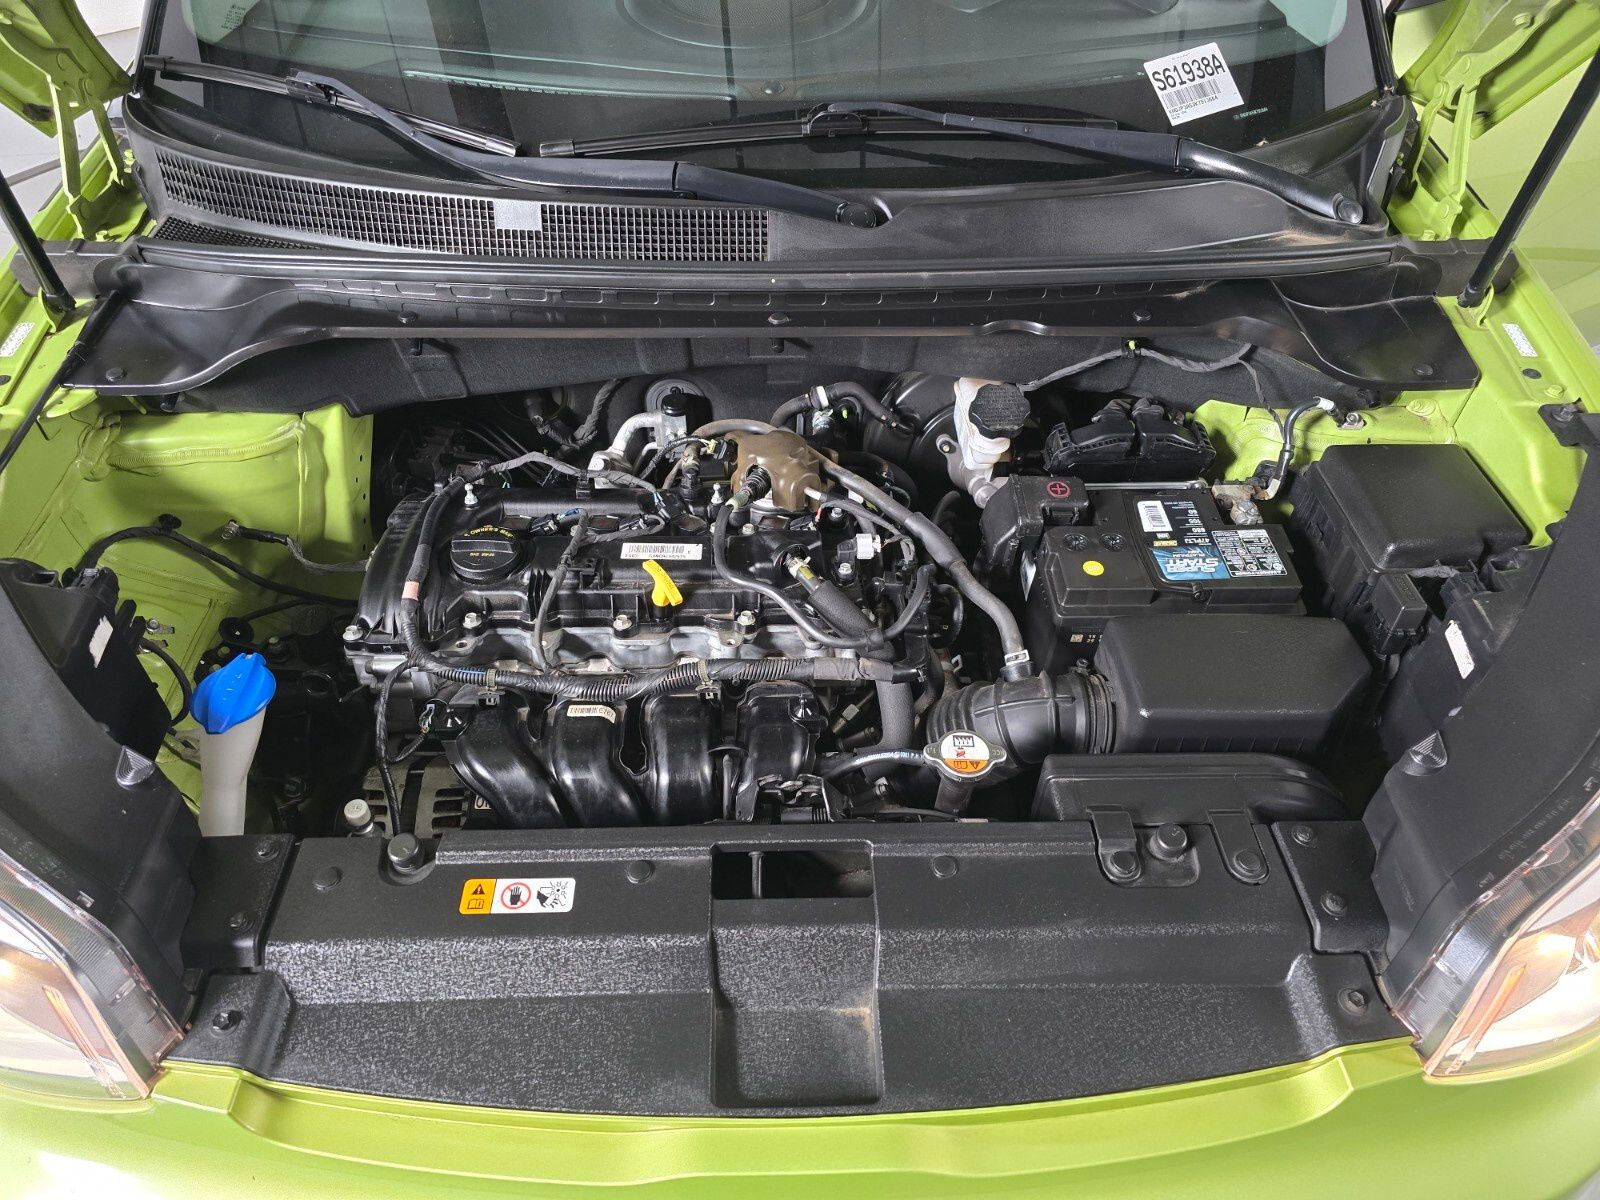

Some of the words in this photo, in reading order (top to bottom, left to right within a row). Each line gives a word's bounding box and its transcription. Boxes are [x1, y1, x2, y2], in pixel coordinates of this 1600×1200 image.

[1152, 53, 1226, 91] S61938A
[1167, 558, 1219, 567] START
[1165, 564, 1216, 573] SUPER
